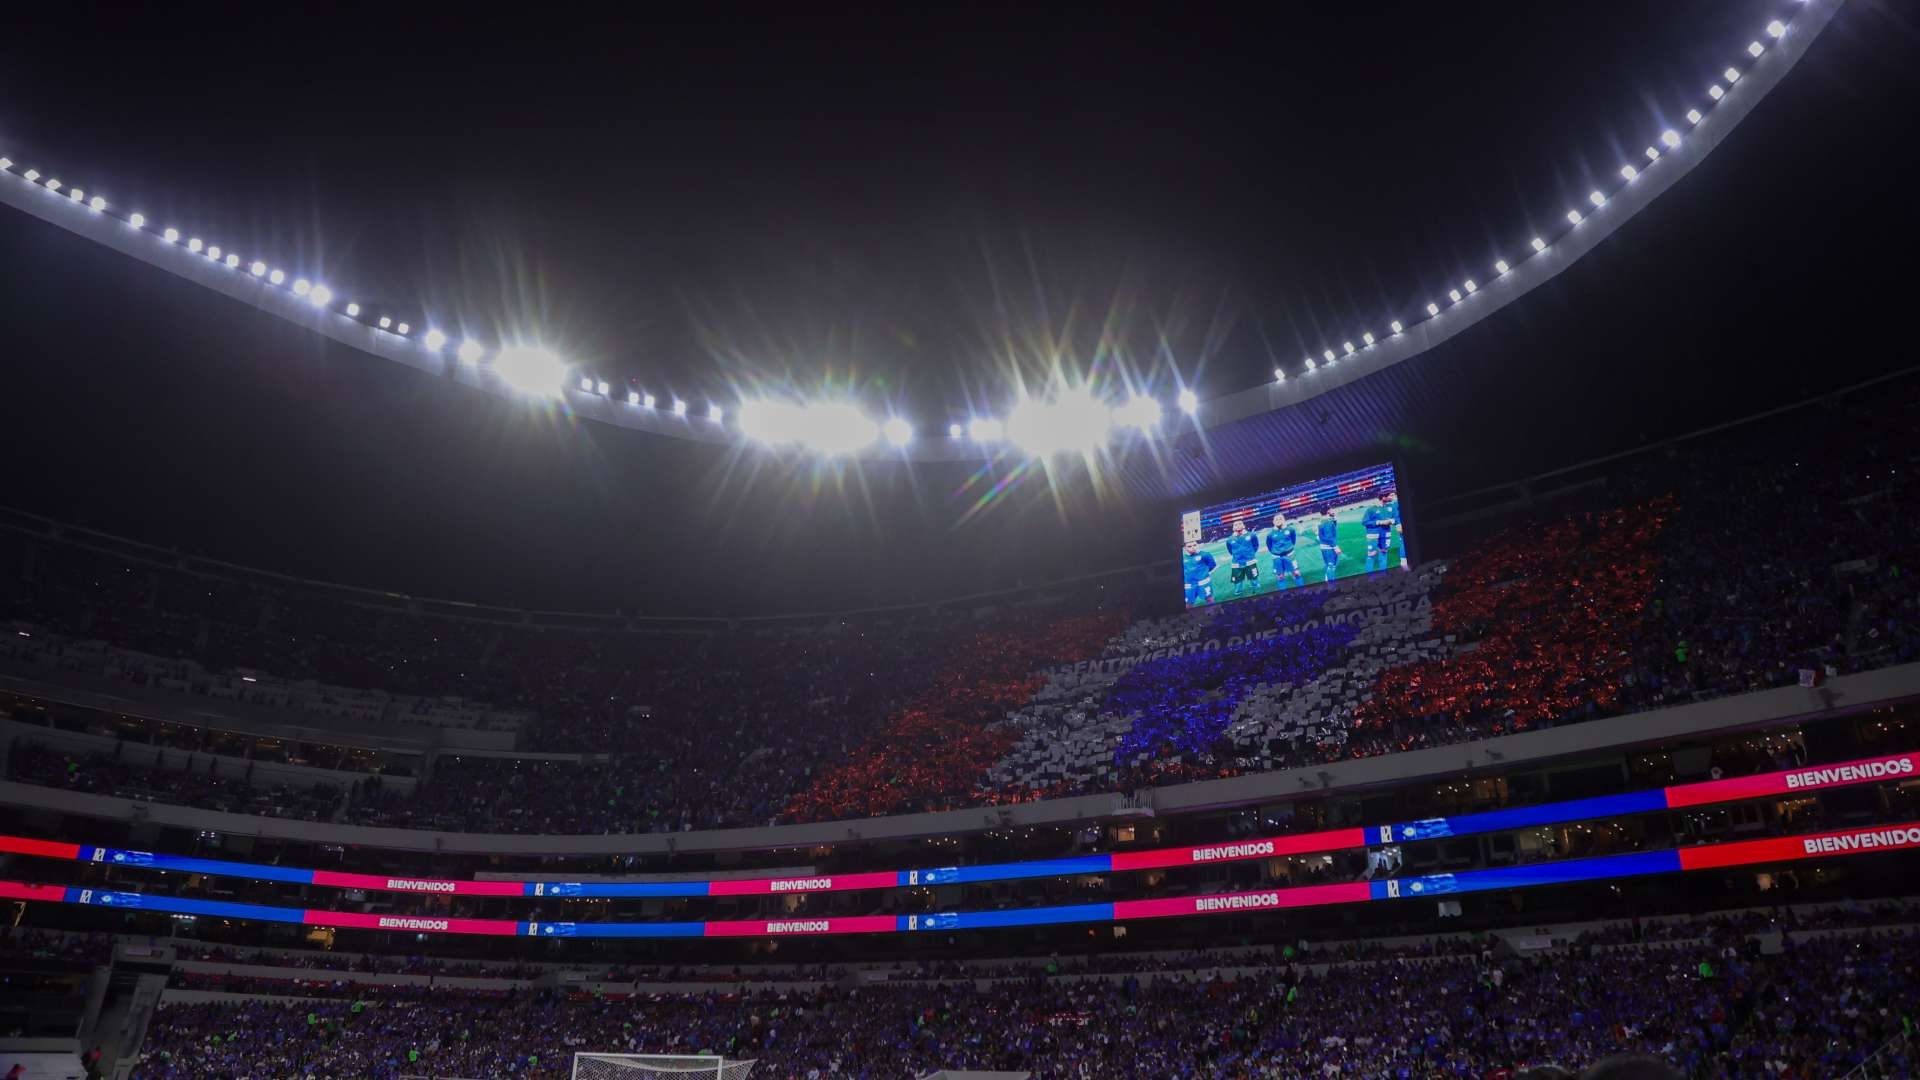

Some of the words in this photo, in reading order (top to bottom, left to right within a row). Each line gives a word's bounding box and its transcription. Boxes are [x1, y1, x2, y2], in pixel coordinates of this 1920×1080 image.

[1786, 758, 1913, 788] BIENVENIDOS
[1804, 828, 1920, 853] BIENVENIDO
[1193, 842, 1274, 861] BIENVENIDOS
[387, 879, 455, 892] BIENVENIDOS
[771, 879, 832, 891] BIENVENIDOS
[1196, 893, 1279, 911] BIENVENIDOS
[379, 917, 448, 930] BIENVENIDOS
[767, 921, 829, 933] BIENVENIDOS
